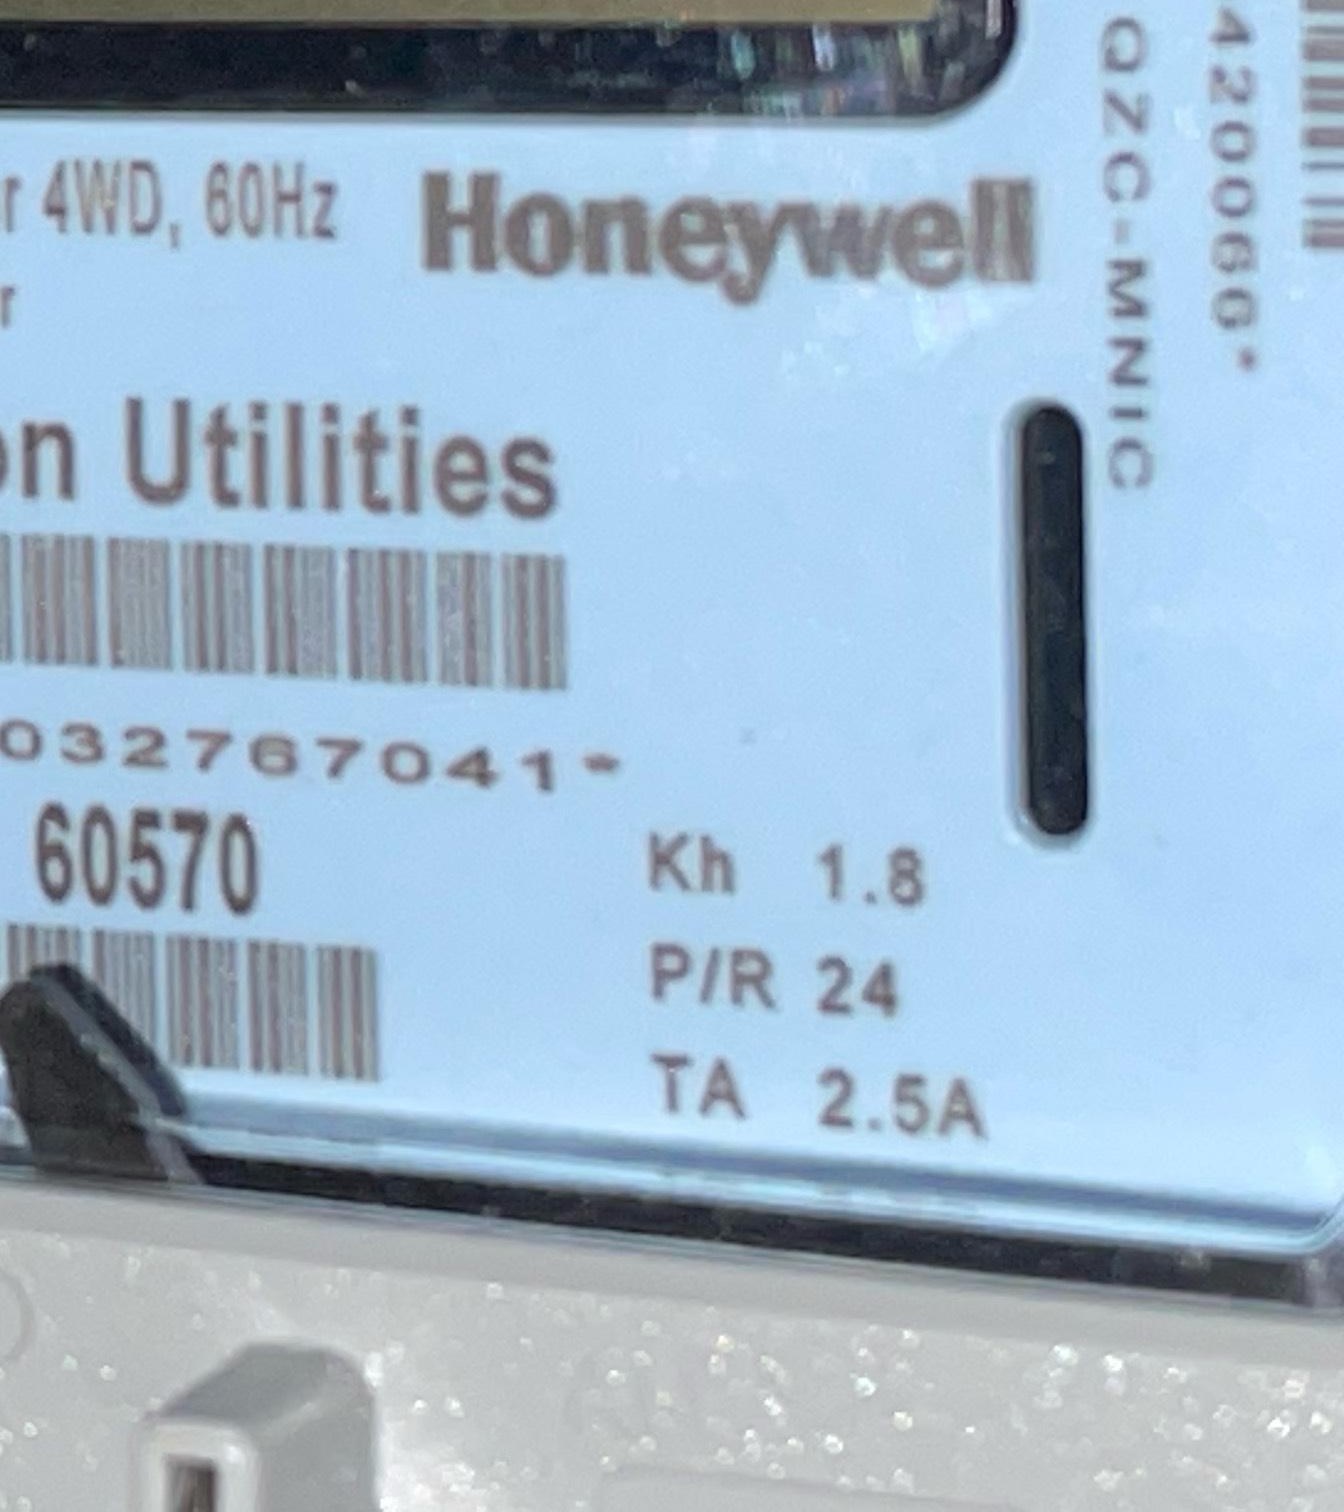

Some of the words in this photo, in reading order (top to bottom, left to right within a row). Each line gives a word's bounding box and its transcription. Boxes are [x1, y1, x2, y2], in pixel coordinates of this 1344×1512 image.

[41, 157, 182, 252] 4WD,
[204, 159, 341, 244] 60Hz
[419, 169, 1040, 310] Honeywell
[1100, 15, 1157, 493] QZC-MNIC
[125, 395, 561, 523] Utilities
[34, 800, 260, 919] 60570
[647, 830, 739, 898] Kh
[817, 842, 927, 910] 1.8
[650, 941, 780, 1014] P/R
[816, 954, 901, 1019] 24
[647, 1050, 749, 1122] TA
[816, 1064, 990, 1142] 2.5A
